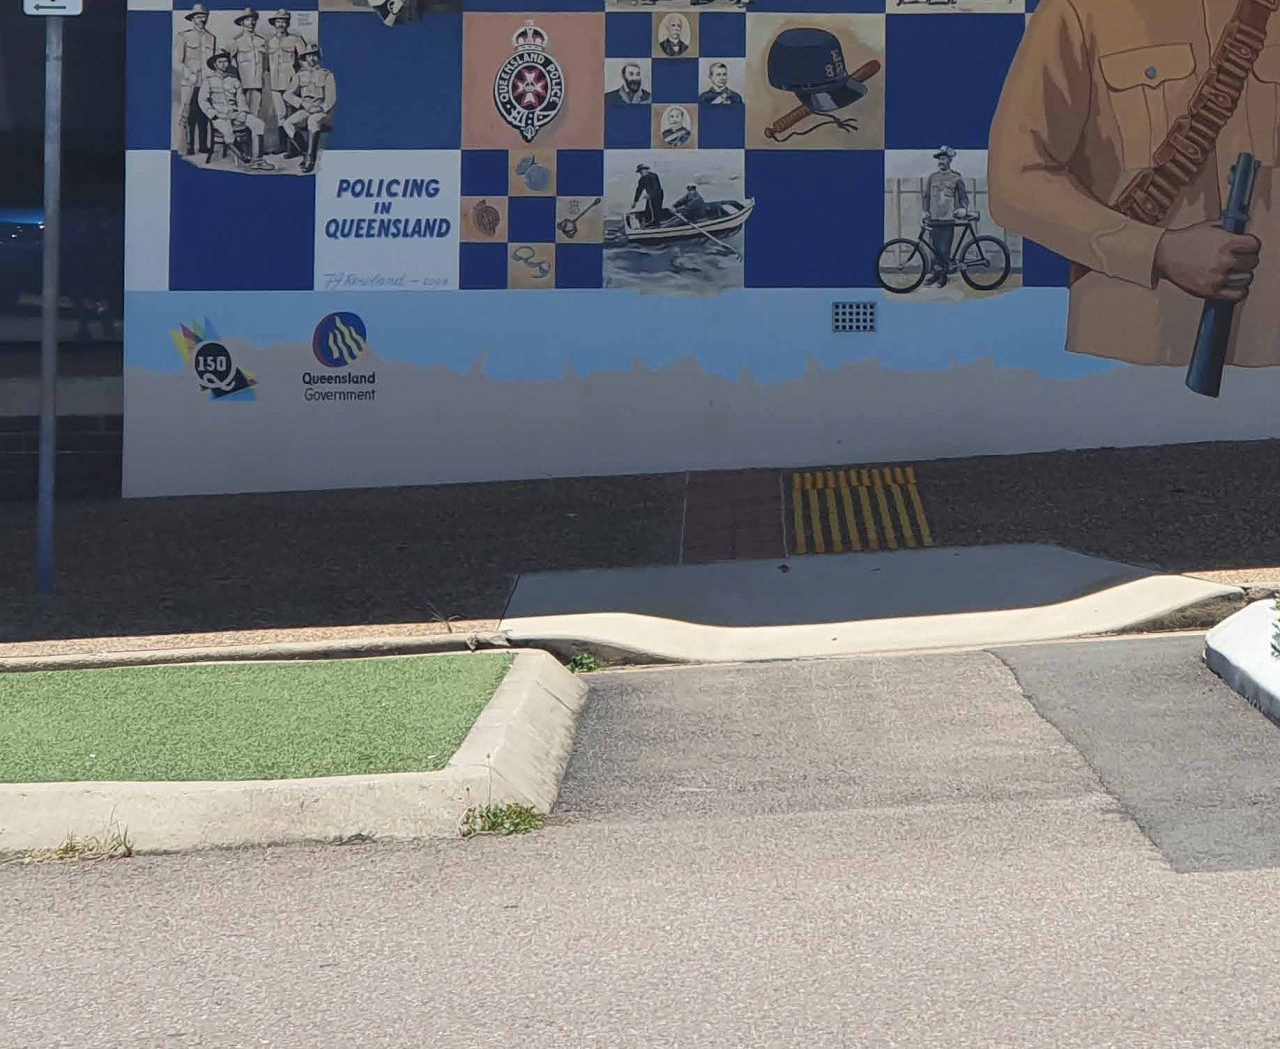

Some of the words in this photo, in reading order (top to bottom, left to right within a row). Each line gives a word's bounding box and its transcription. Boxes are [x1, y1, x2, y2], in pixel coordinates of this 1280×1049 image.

[498, 52, 545, 103] QUEENSLAND
[546, 63, 562, 104] POLICE
[336, 178, 440, 199] POLICING
[373, 201, 392, 214] IN
[325, 218, 451, 240] QUEENSLAND
[198, 356, 227, 372] 150
[302, 372, 375, 385] Queensland
[304, 388, 375, 401] Government
